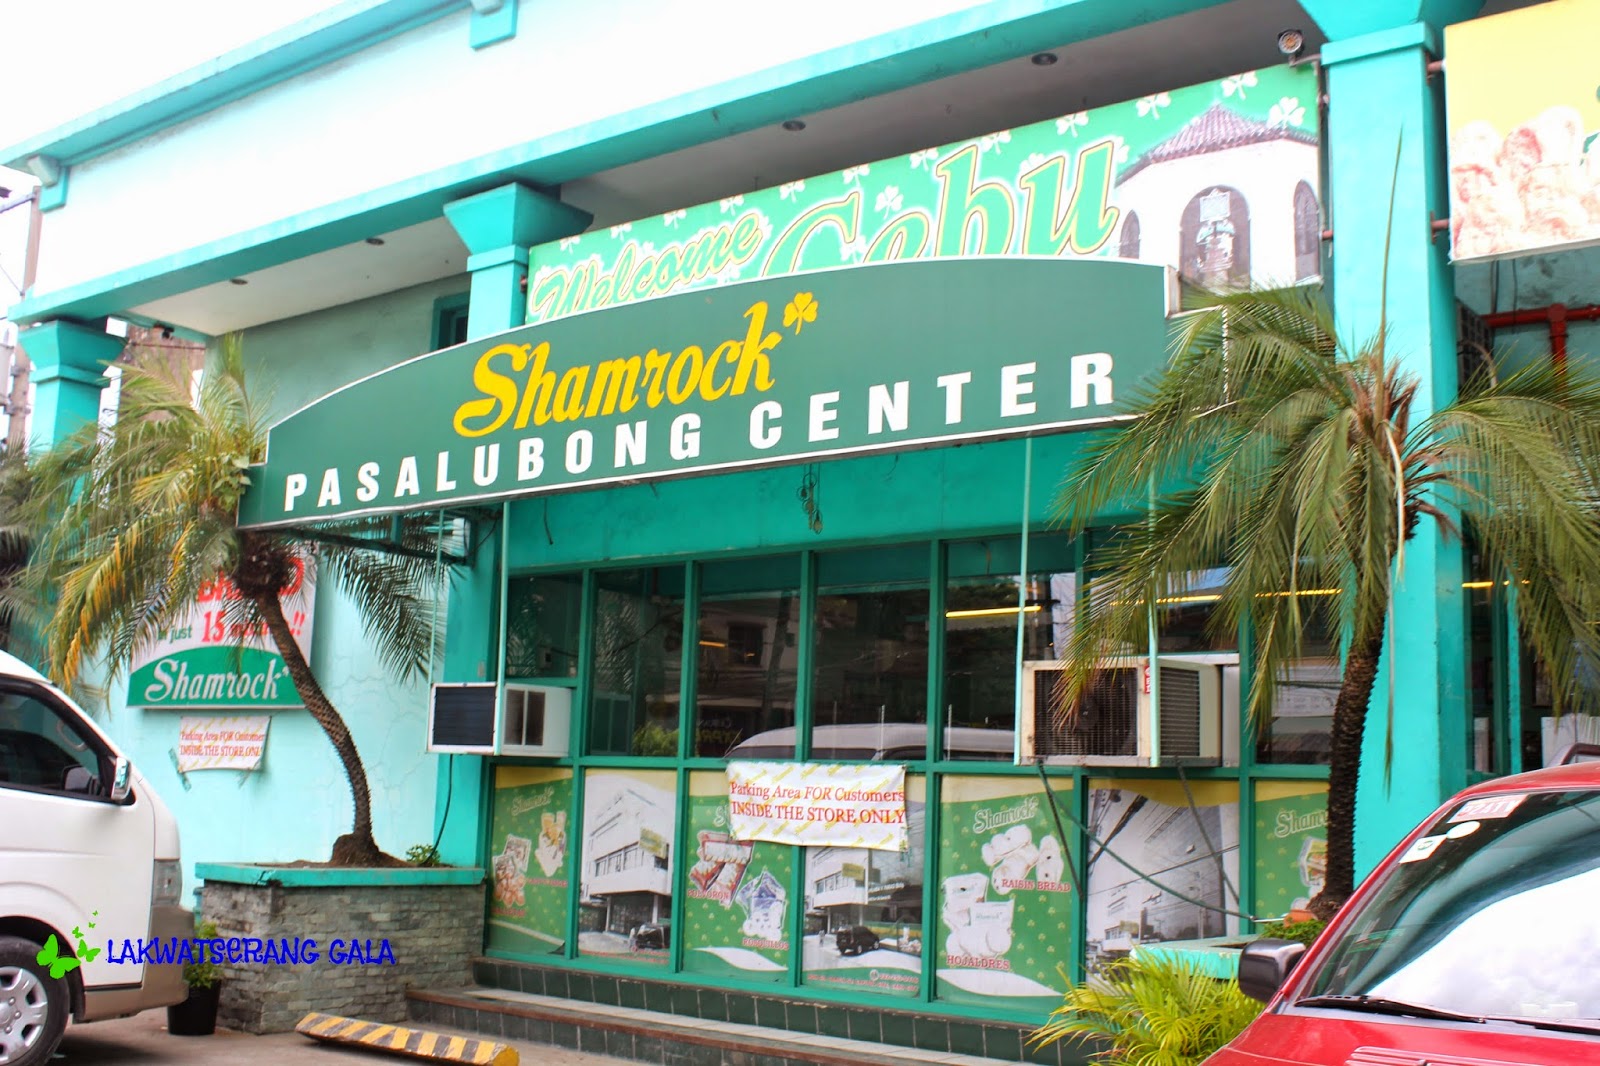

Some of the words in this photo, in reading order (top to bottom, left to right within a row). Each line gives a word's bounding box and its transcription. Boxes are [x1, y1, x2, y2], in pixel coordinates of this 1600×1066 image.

[532, 213, 763, 321] Welcome
[453, 301, 782, 438] Shamrock
[284, 412, 701, 512] PASALUBONG
[749, 352, 1114, 450] CENTER
[170, 625, 193, 644] just
[202, 611, 226, 643] 15
[145, 657, 281, 702] Shamrock
[204, 745, 220, 757] THE
[220, 745, 246, 757] STORE
[246, 746, 263, 757] ONL
[729, 781, 770, 800] Parking
[771, 784, 801, 800] Area
[804, 785, 832, 800] FOR
[835, 787, 905, 803] Customers
[731, 801, 773, 819] INSIDE
[774, 804, 805, 822] THE
[806, 806, 857, 824] STORE
[859, 808, 906, 825] ONLY
[973, 797, 1036, 834] Shamrock
[1001, 878, 1035, 891] RAISIN
[1037, 880, 1072, 893] BREAD
[946, 954, 1011, 970] HOJALDRES
